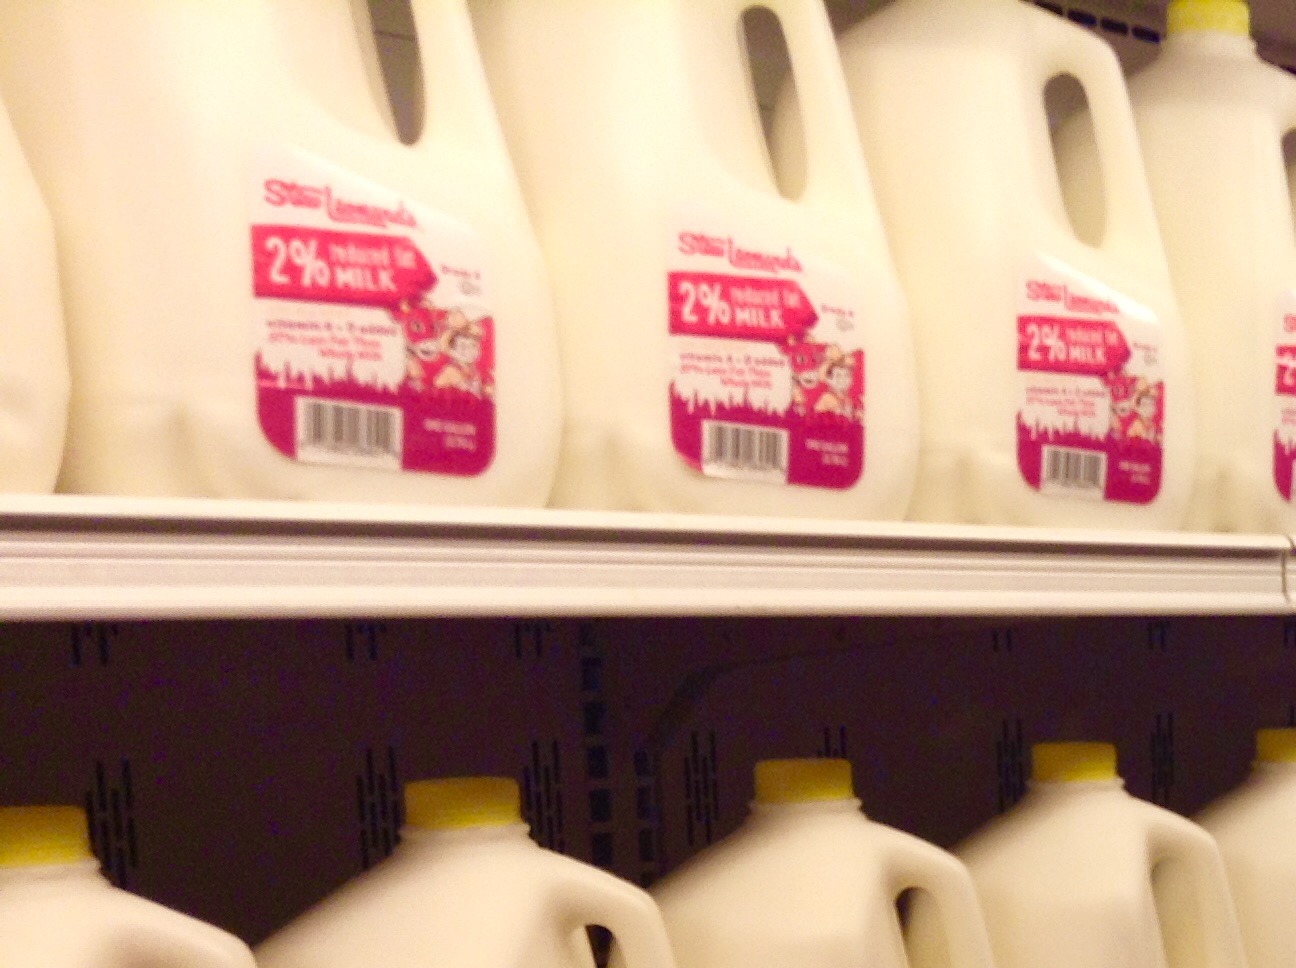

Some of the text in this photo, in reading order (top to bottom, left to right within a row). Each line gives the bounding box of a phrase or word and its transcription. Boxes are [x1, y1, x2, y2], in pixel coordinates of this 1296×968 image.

[265, 236, 331, 287] 2%
[335, 267, 398, 292] MILK
[678, 281, 731, 325] 2%
[733, 307, 785, 329] MILK
[1026, 323, 1067, 362] 2%
